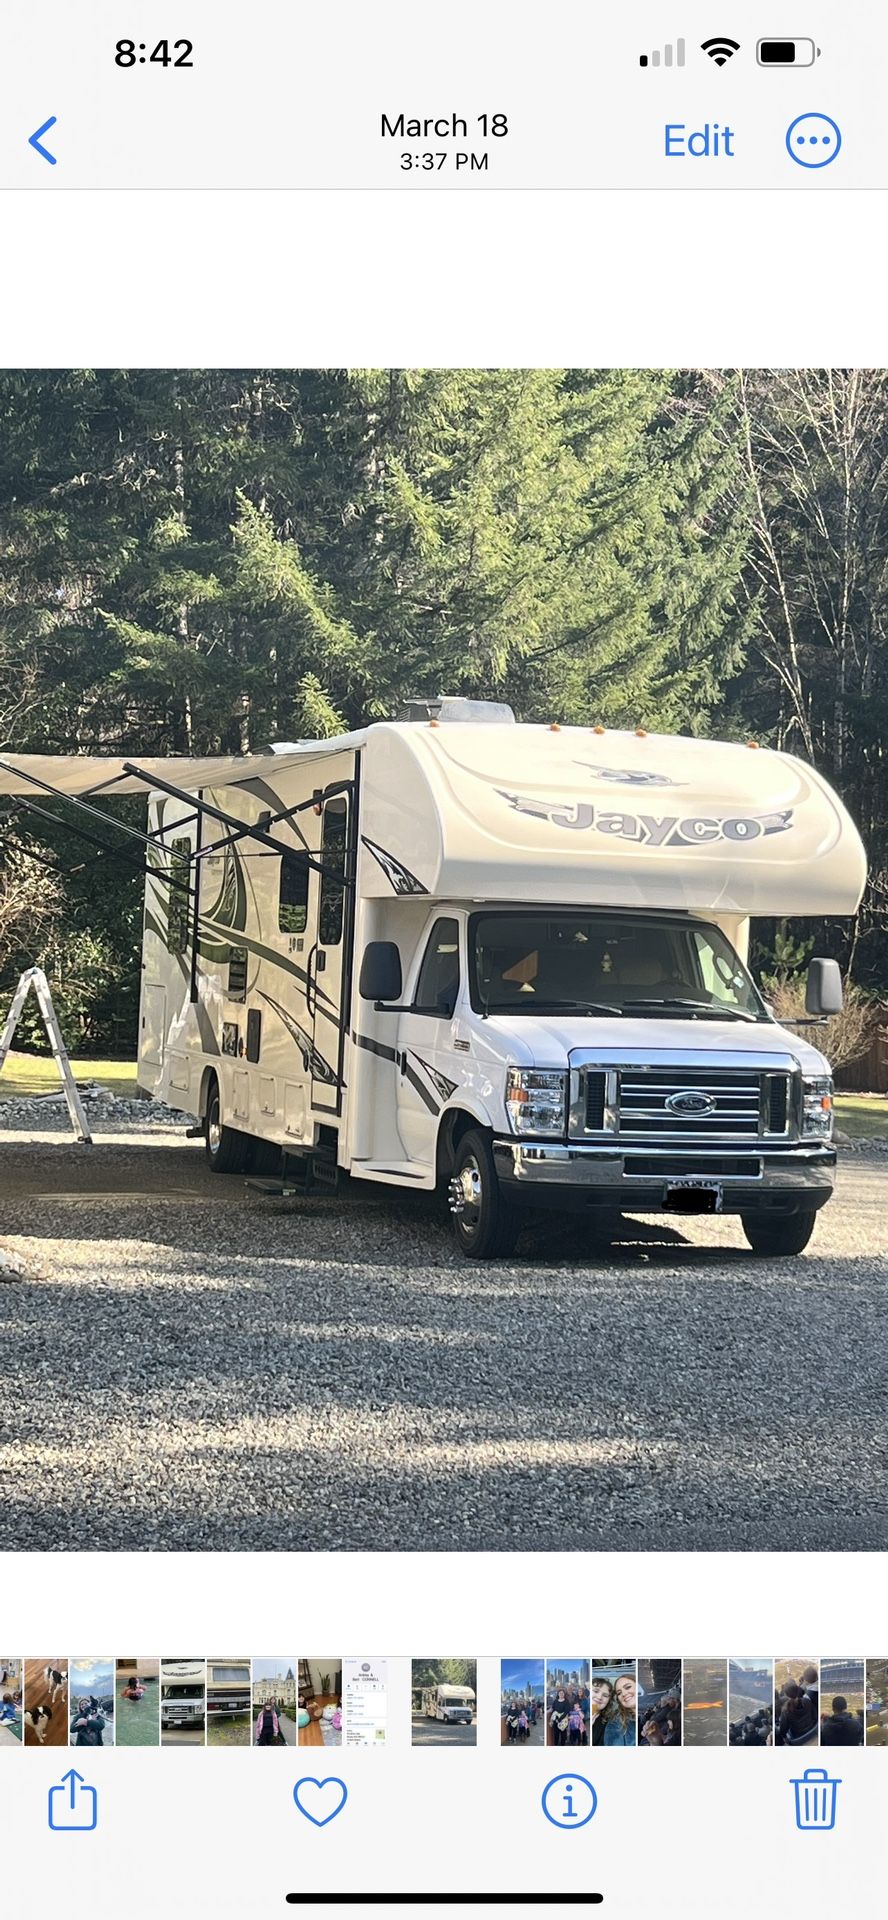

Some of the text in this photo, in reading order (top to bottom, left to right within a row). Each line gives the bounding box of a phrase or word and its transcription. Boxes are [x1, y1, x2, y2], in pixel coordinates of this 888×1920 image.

[114, 38, 194, 68] 8:42
[381, 112, 509, 138] March 18
[664, 123, 735, 158] Edit
[400, 152, 489, 171] 3:37 PM
[551, 803, 761, 846] Jayco
